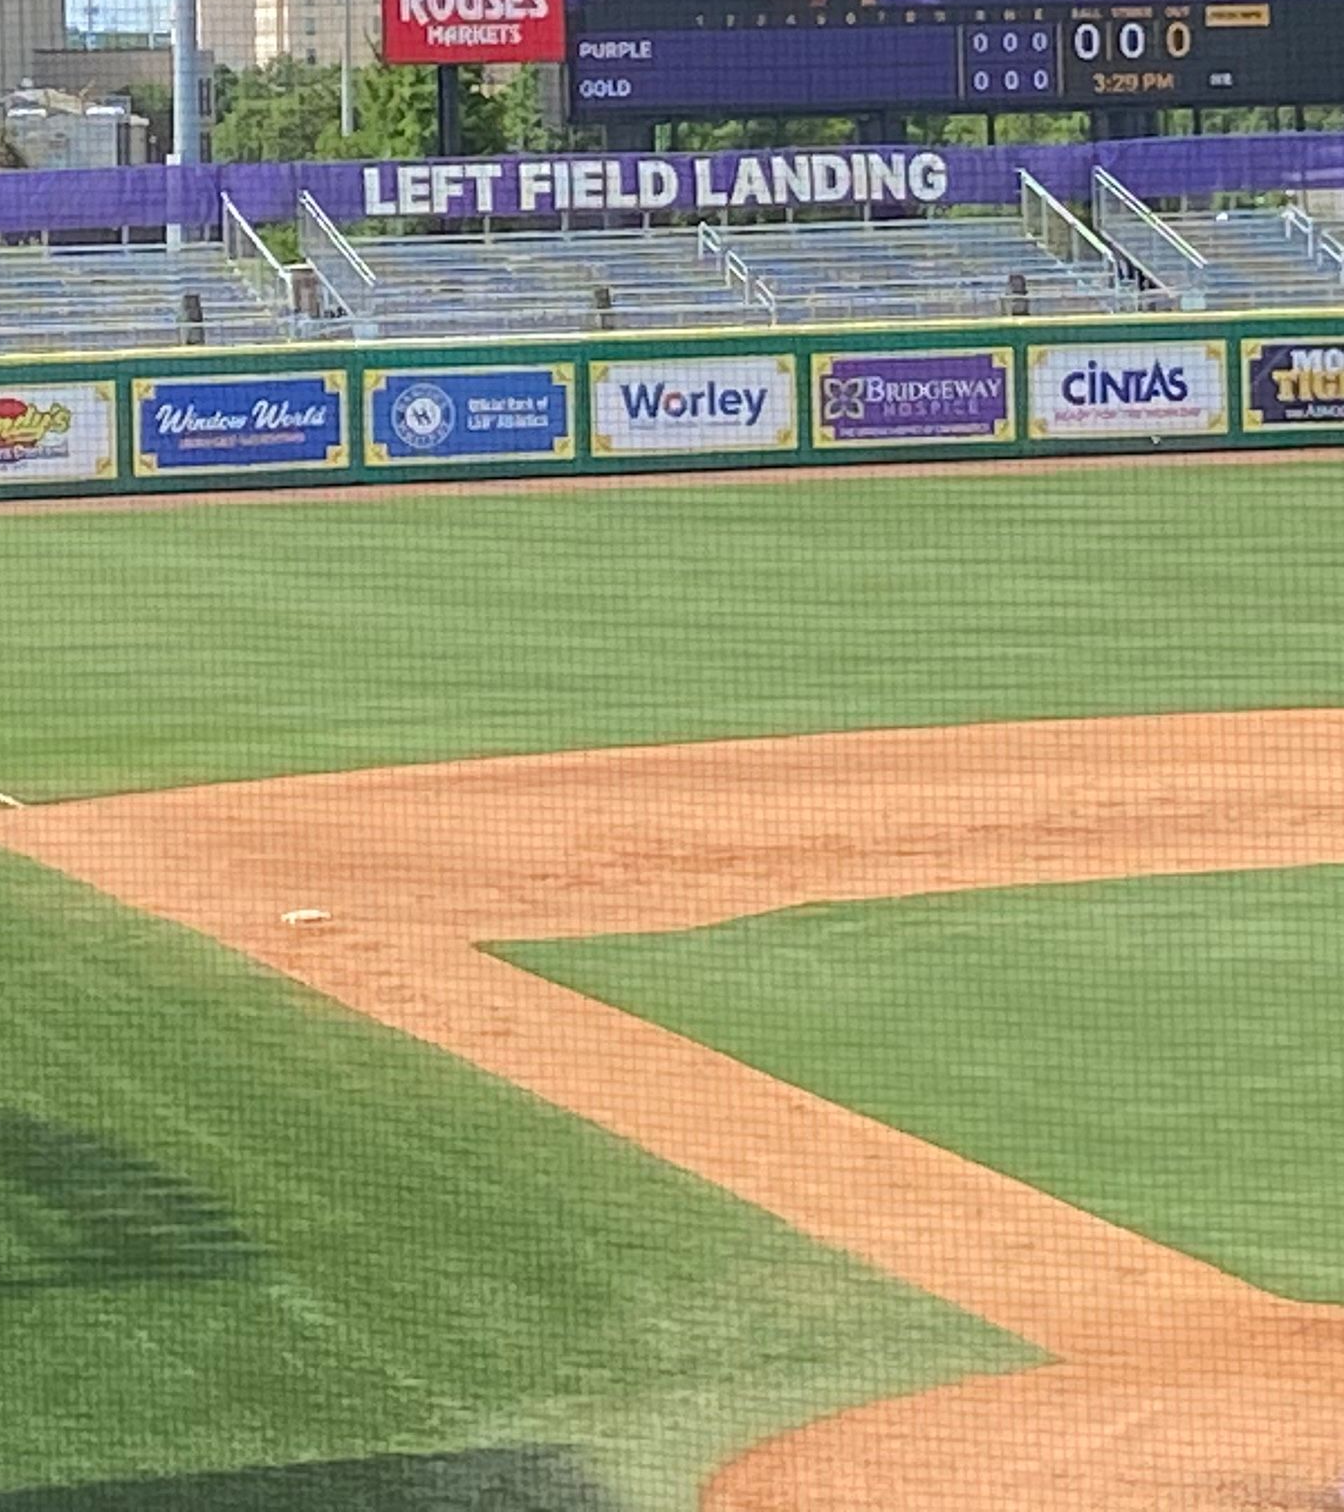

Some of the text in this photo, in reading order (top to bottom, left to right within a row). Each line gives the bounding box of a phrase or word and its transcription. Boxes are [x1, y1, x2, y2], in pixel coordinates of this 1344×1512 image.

[426, 23, 523, 47] MARKETS
[578, 32, 1048, 59] PURPLE 0 0 0
[1074, 21, 1191, 61] 0 0 0
[578, 69, 1049, 99] GOLD 0 0 0
[1092, 72, 1175, 93] 3:29 PM
[363, 152, 948, 216] LEFT FIELD LANDING
[620, 380, 768, 426] Worley
[865, 375, 1002, 403] BRIDGEWAY
[155, 399, 327, 433] Window World
[882, 400, 980, 417] HOSPICE
